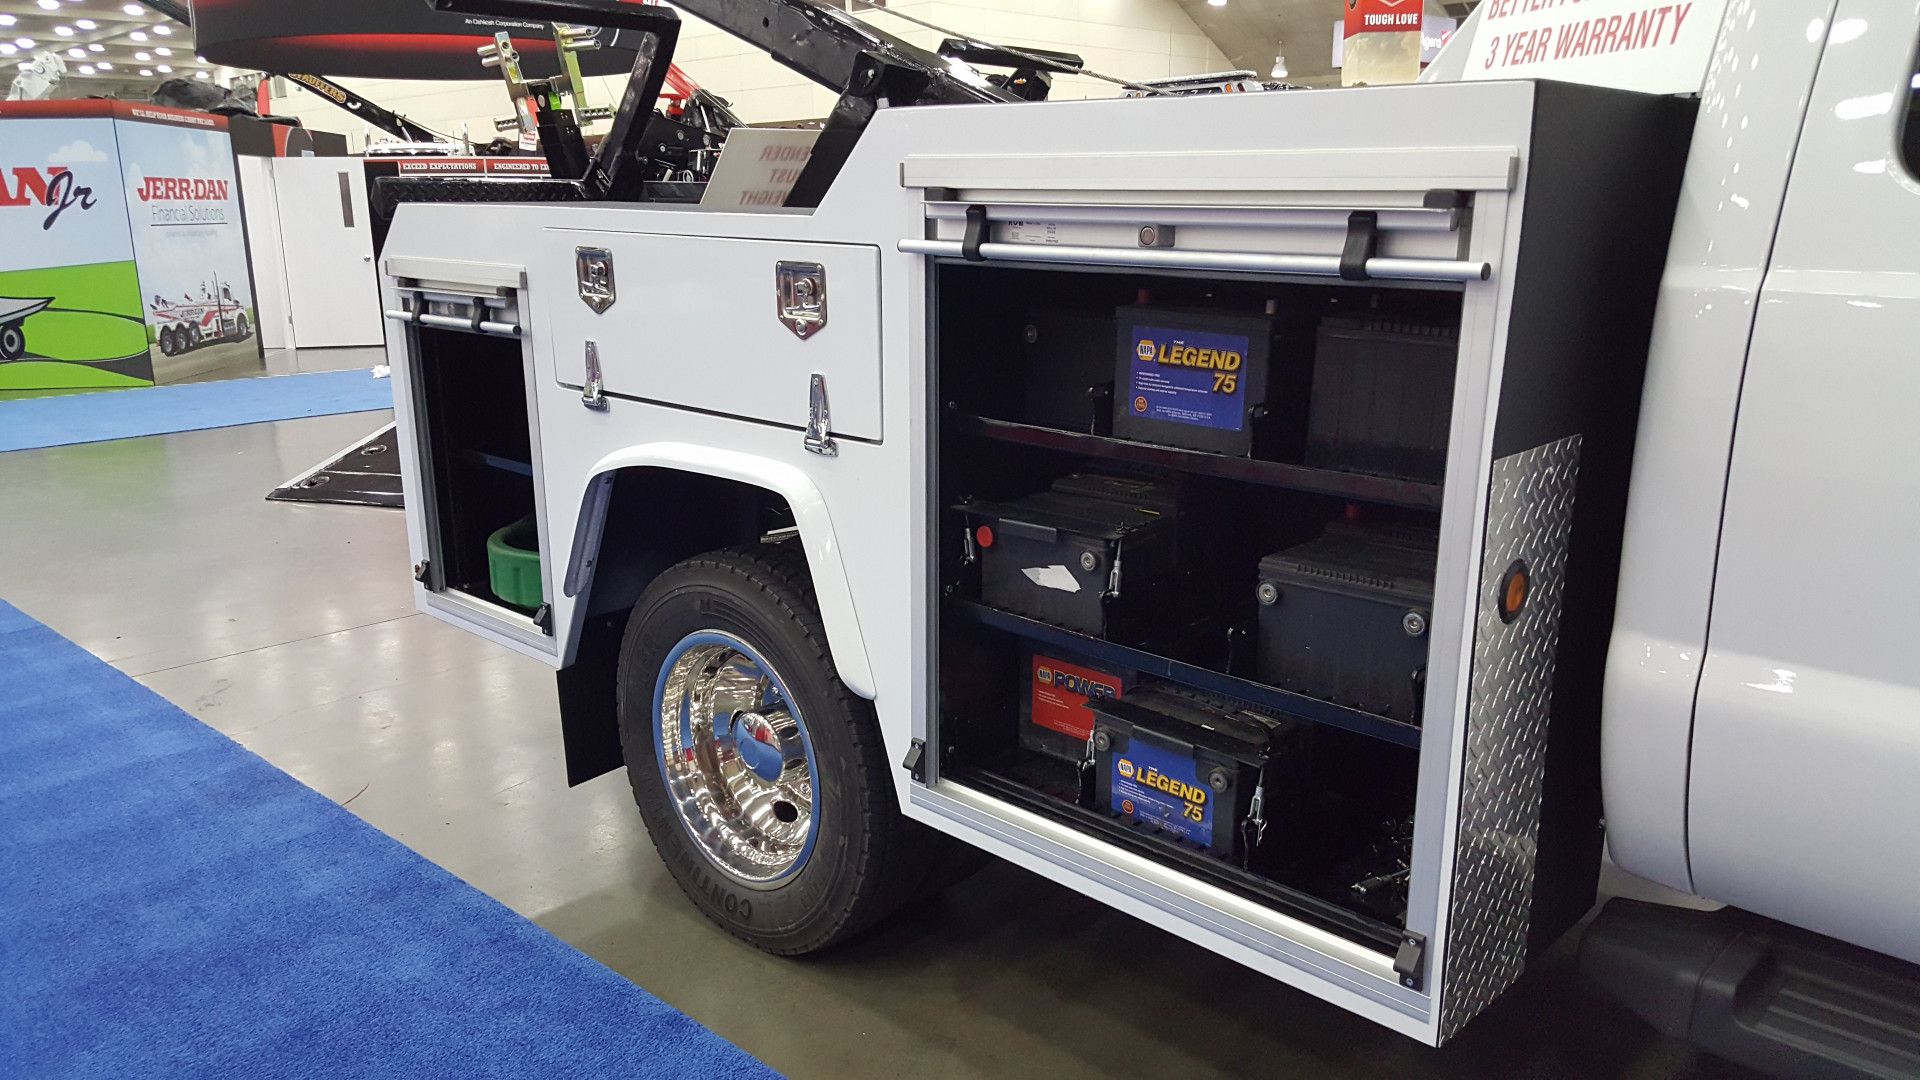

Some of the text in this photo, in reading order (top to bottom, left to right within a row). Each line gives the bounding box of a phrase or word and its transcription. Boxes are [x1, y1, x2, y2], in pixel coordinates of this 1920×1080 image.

[522, 21, 545, 30] Company
[1364, 13, 1418, 26] TOUGH LOVE
[1485, 2, 1693, 70] 3 YEAR WARRANTY
[403, 162, 477, 170] EXCEED EXPECTATIONS
[493, 163, 531, 171] ENGINEERED
[43, 170, 98, 230] Jr
[151, 205, 225, 221] Financial Solutions
[1139, 344, 1154, 356] NAPA
[1158, 343, 1242, 371] LEGEND
[1212, 372, 1238, 394] 75
[1039, 669, 1116, 699] NAPA POWER
[1120, 762, 1133, 774] NAPA
[1136, 767, 1207, 804] LEGEND
[1183, 801, 1203, 823] 75
